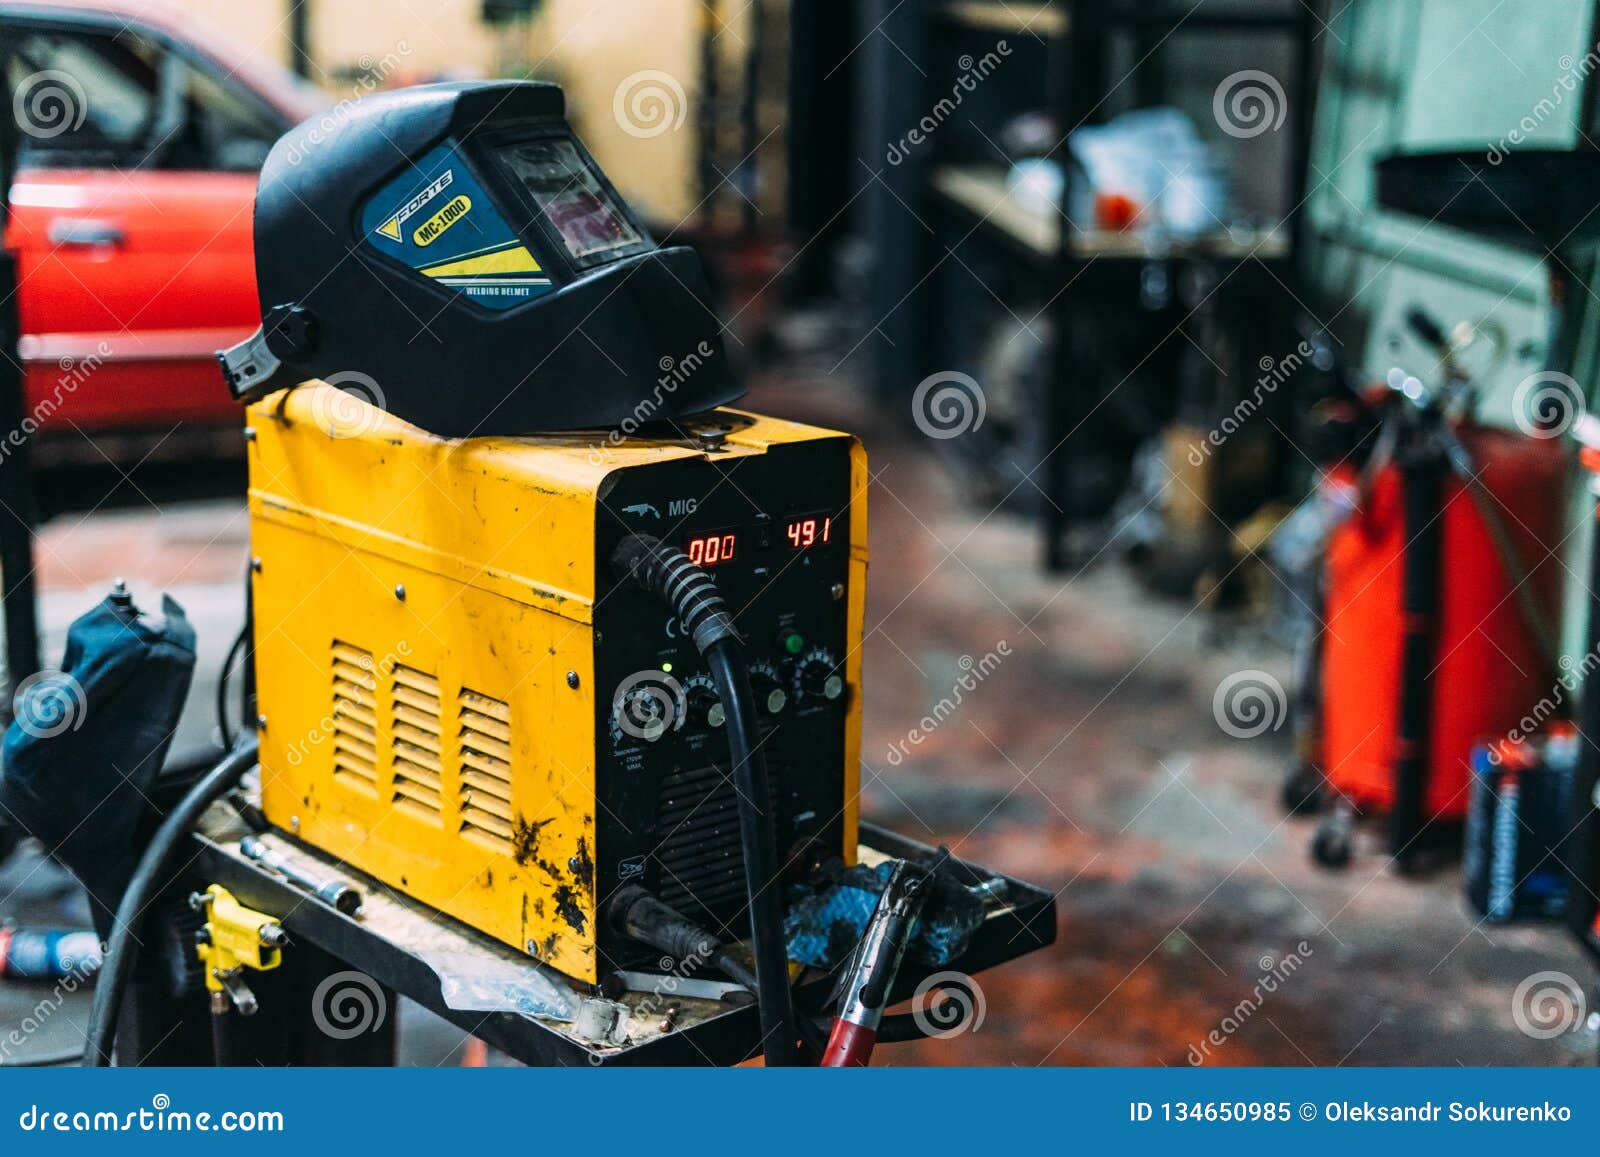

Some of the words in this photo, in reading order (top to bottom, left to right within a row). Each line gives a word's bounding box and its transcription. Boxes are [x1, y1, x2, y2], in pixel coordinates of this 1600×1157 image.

[397, 171, 453, 223] FORTE
[417, 198, 467, 243] MC-1000
[466, 287, 500, 297] WELDING
[501, 287, 530, 297] HELMET
[668, 499, 698, 517] MIG
[787, 517, 832, 548] 491
[688, 534, 736, 566] 000
